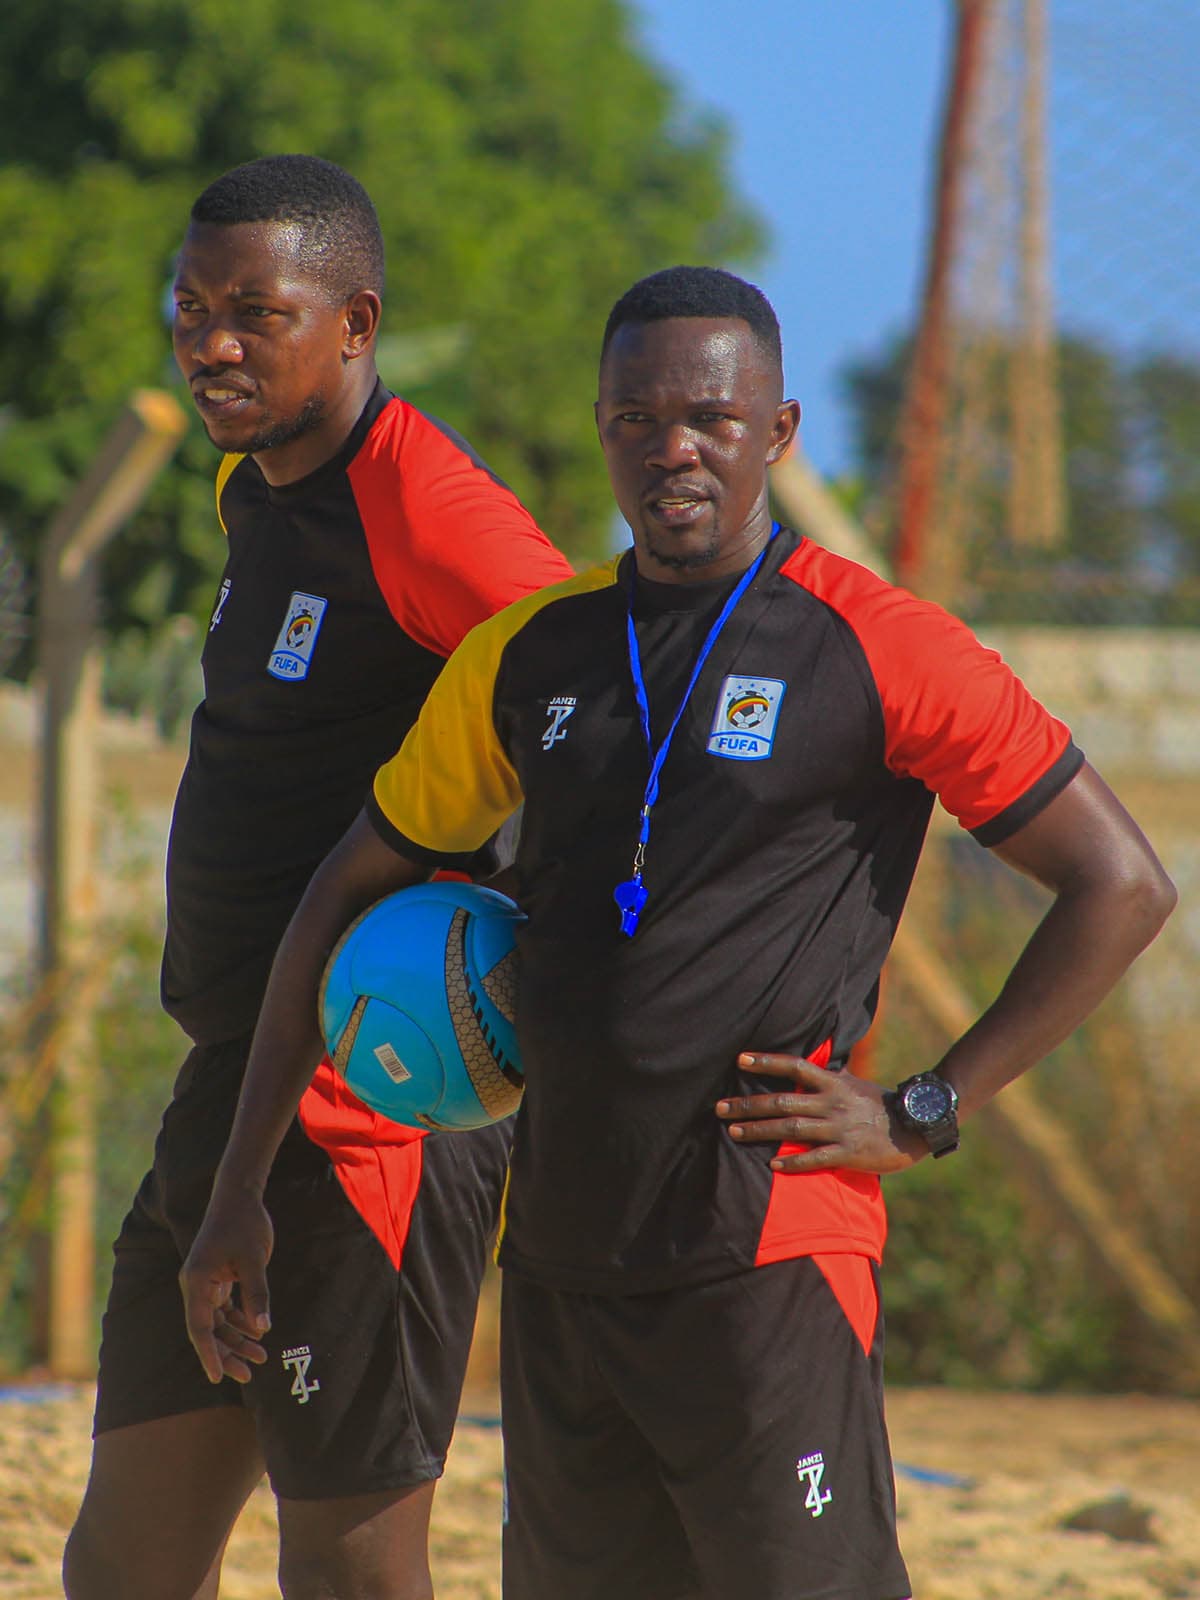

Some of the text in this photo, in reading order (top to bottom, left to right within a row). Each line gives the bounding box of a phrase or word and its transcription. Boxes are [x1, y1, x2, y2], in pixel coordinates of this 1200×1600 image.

[274, 656, 298, 673] FUFA
[718, 737, 758, 752] FUFA
[281, 1346, 310, 1359] JANZI
[797, 1453, 823, 1469] JANZI
